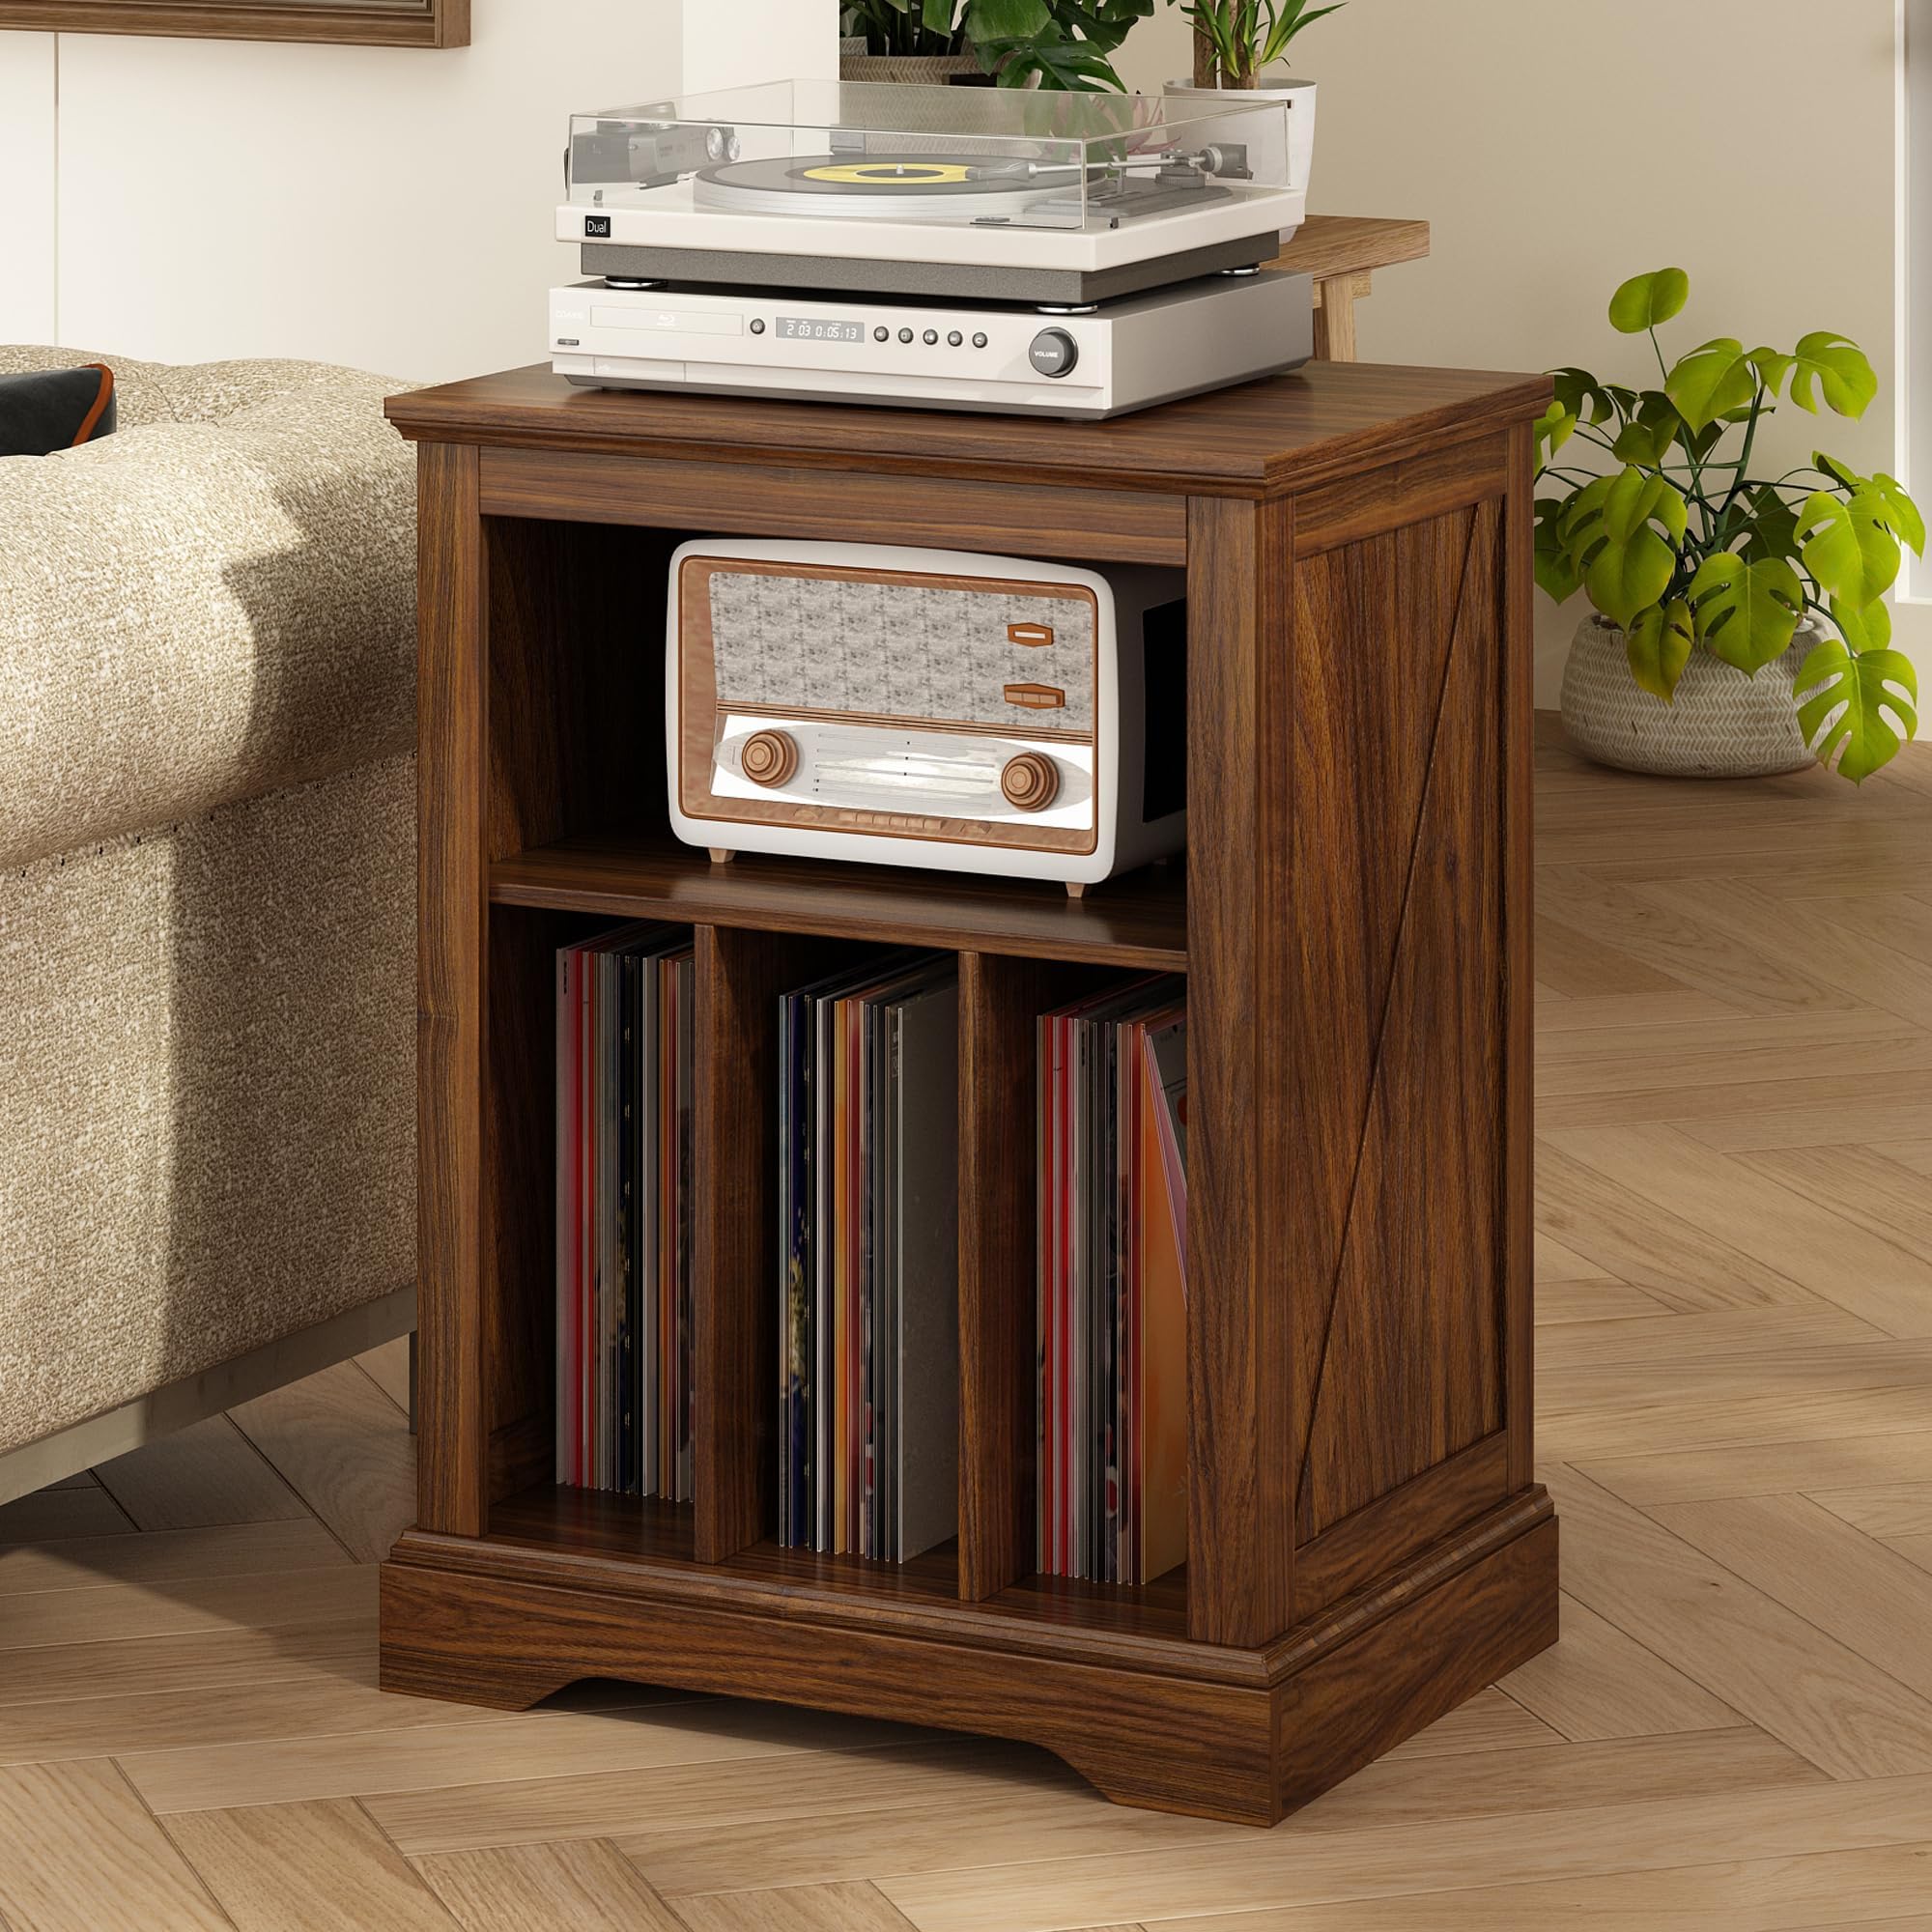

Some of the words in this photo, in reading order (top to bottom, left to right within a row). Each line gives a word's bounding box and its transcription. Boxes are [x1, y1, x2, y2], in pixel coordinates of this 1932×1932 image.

[587, 220, 607, 233] Dual
[787, 325, 794, 335] 2
[799, 325, 810, 336] 03
[815, 326, 857, 339] 0:05:13
